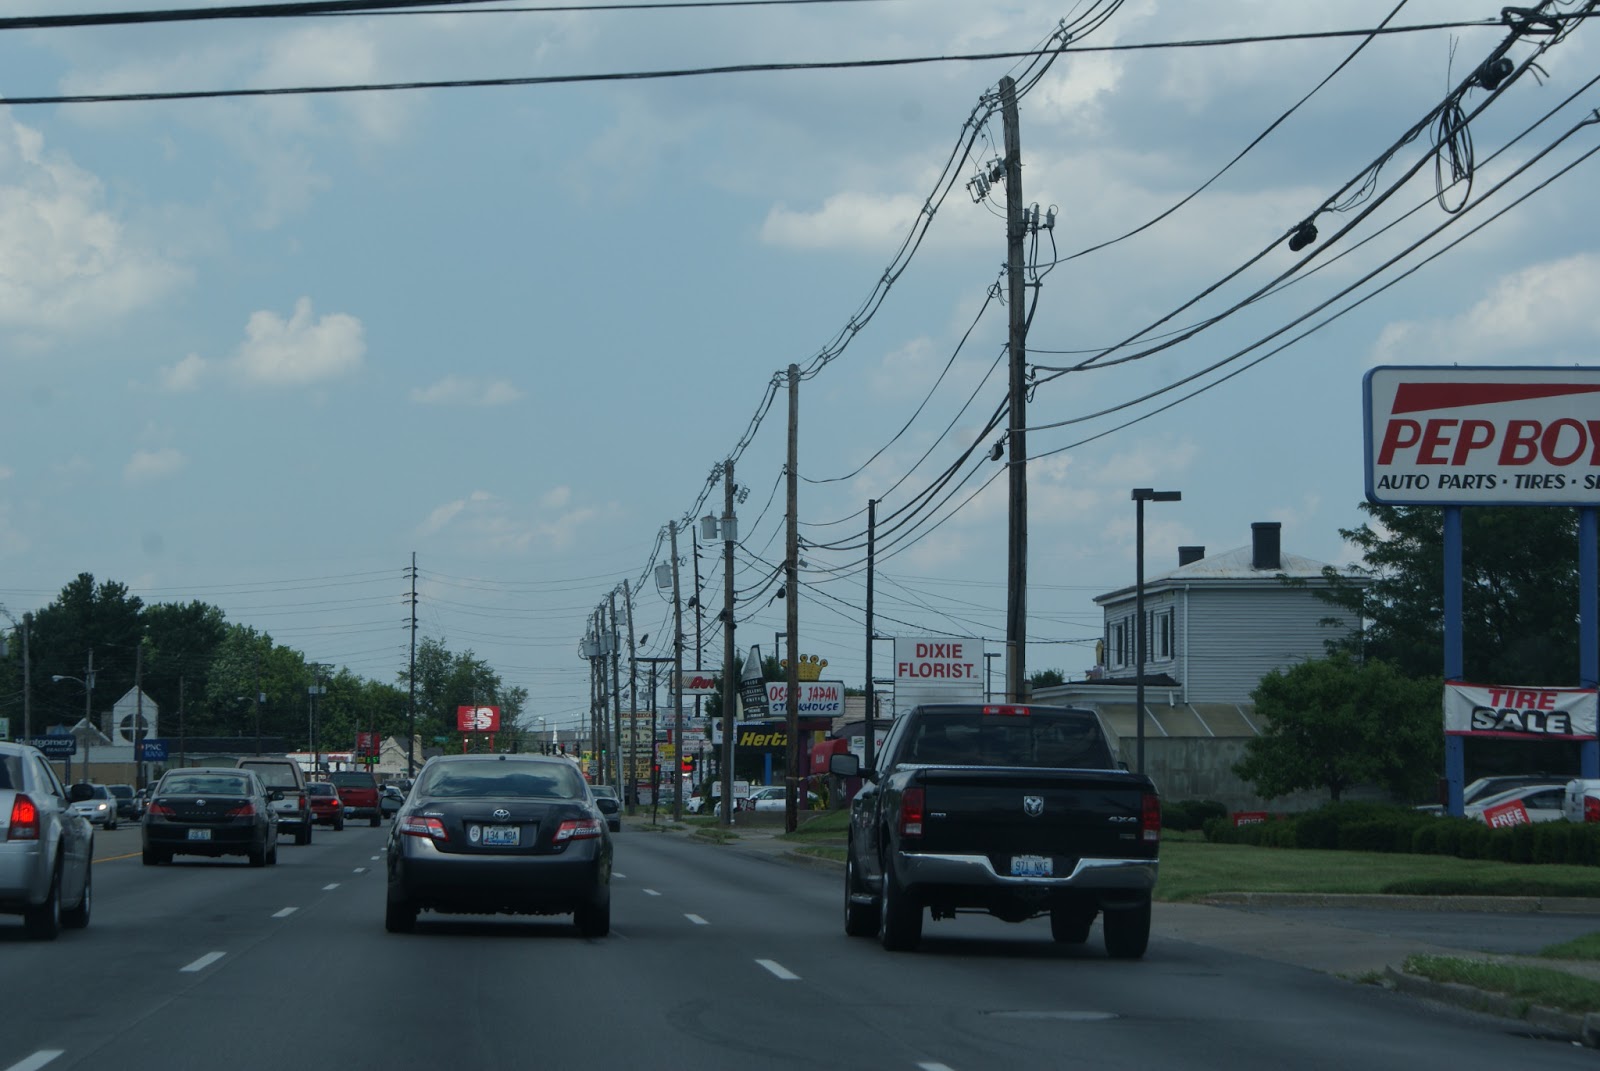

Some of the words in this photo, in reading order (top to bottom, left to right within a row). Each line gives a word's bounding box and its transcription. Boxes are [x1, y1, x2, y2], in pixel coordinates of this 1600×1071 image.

[1377, 418, 1496, 466] PEP
[1377, 474, 1430, 490] AUTO
[1437, 474, 1498, 490] PARTS
[1514, 474, 1566, 490] TIRES
[916, 643, 963, 659] DIXIE
[898, 662, 974, 678] FLORIST
[807, 686, 839, 702] JAPAN
[1488, 689, 1558, 710] TIRE
[772, 702, 840, 712] STKHOUSE
[1472, 706, 1573, 735] SALE
[15, 738, 75, 747] Mntgomery
[740, 731, 788, 747] Hertz
[1490, 808, 1527, 829] FREE
[1015, 860, 1029, 871] 971
[1034, 861, 1048, 872] NKE
